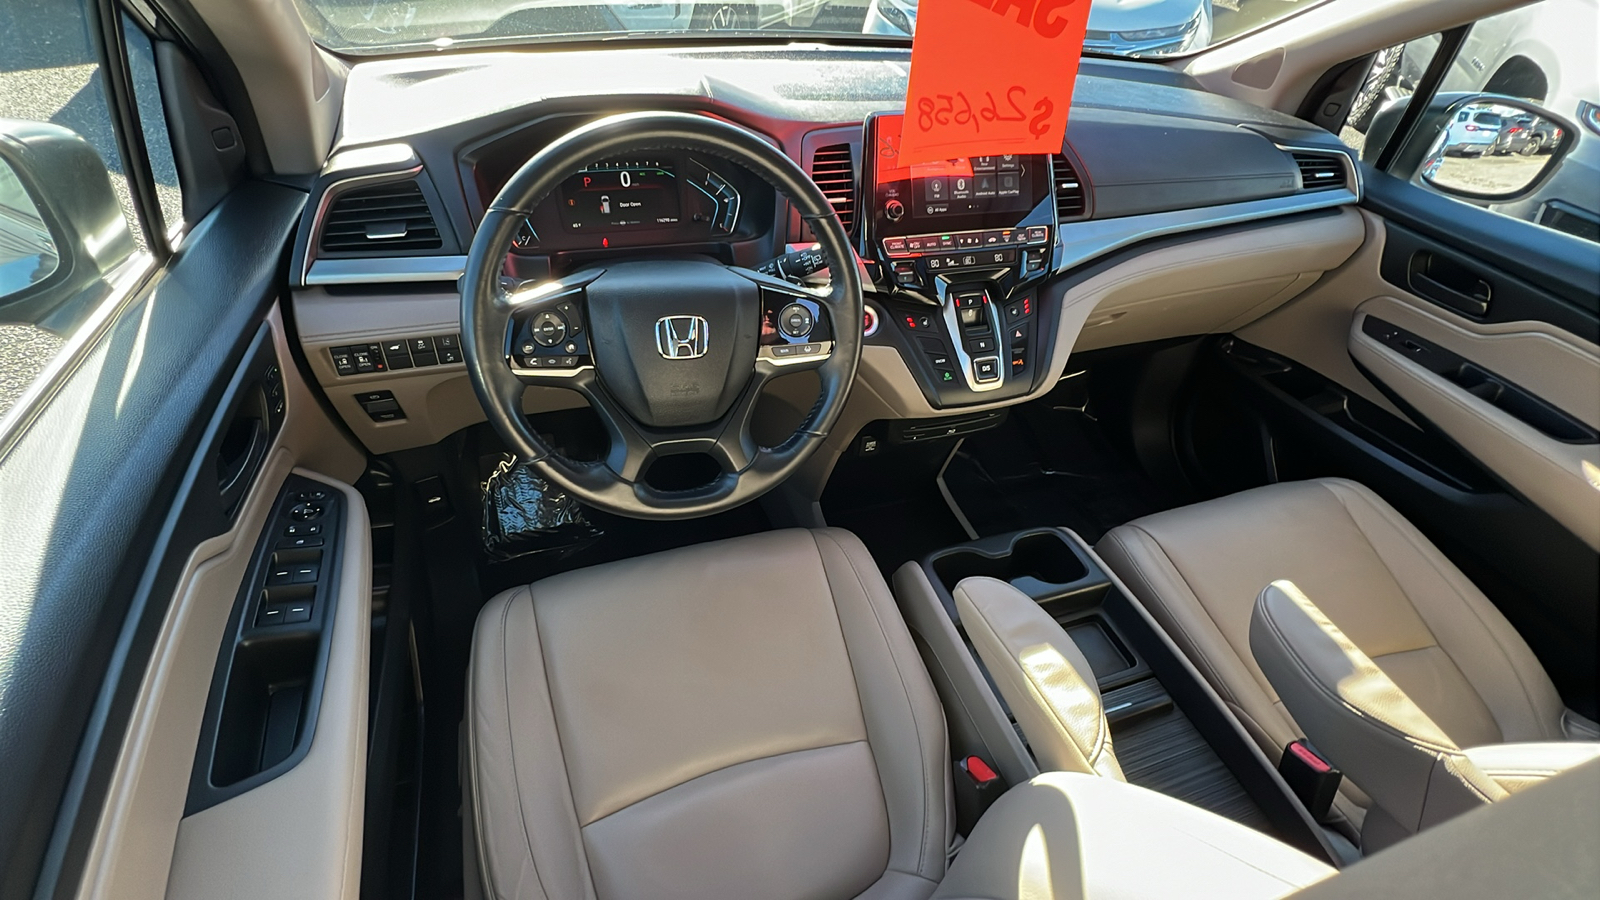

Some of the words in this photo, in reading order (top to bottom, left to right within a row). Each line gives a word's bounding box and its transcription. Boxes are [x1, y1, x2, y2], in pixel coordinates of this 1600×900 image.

[583, 177, 592, 187] P
[620, 171, 631, 188] 0
[930, 259, 940, 268] 80
